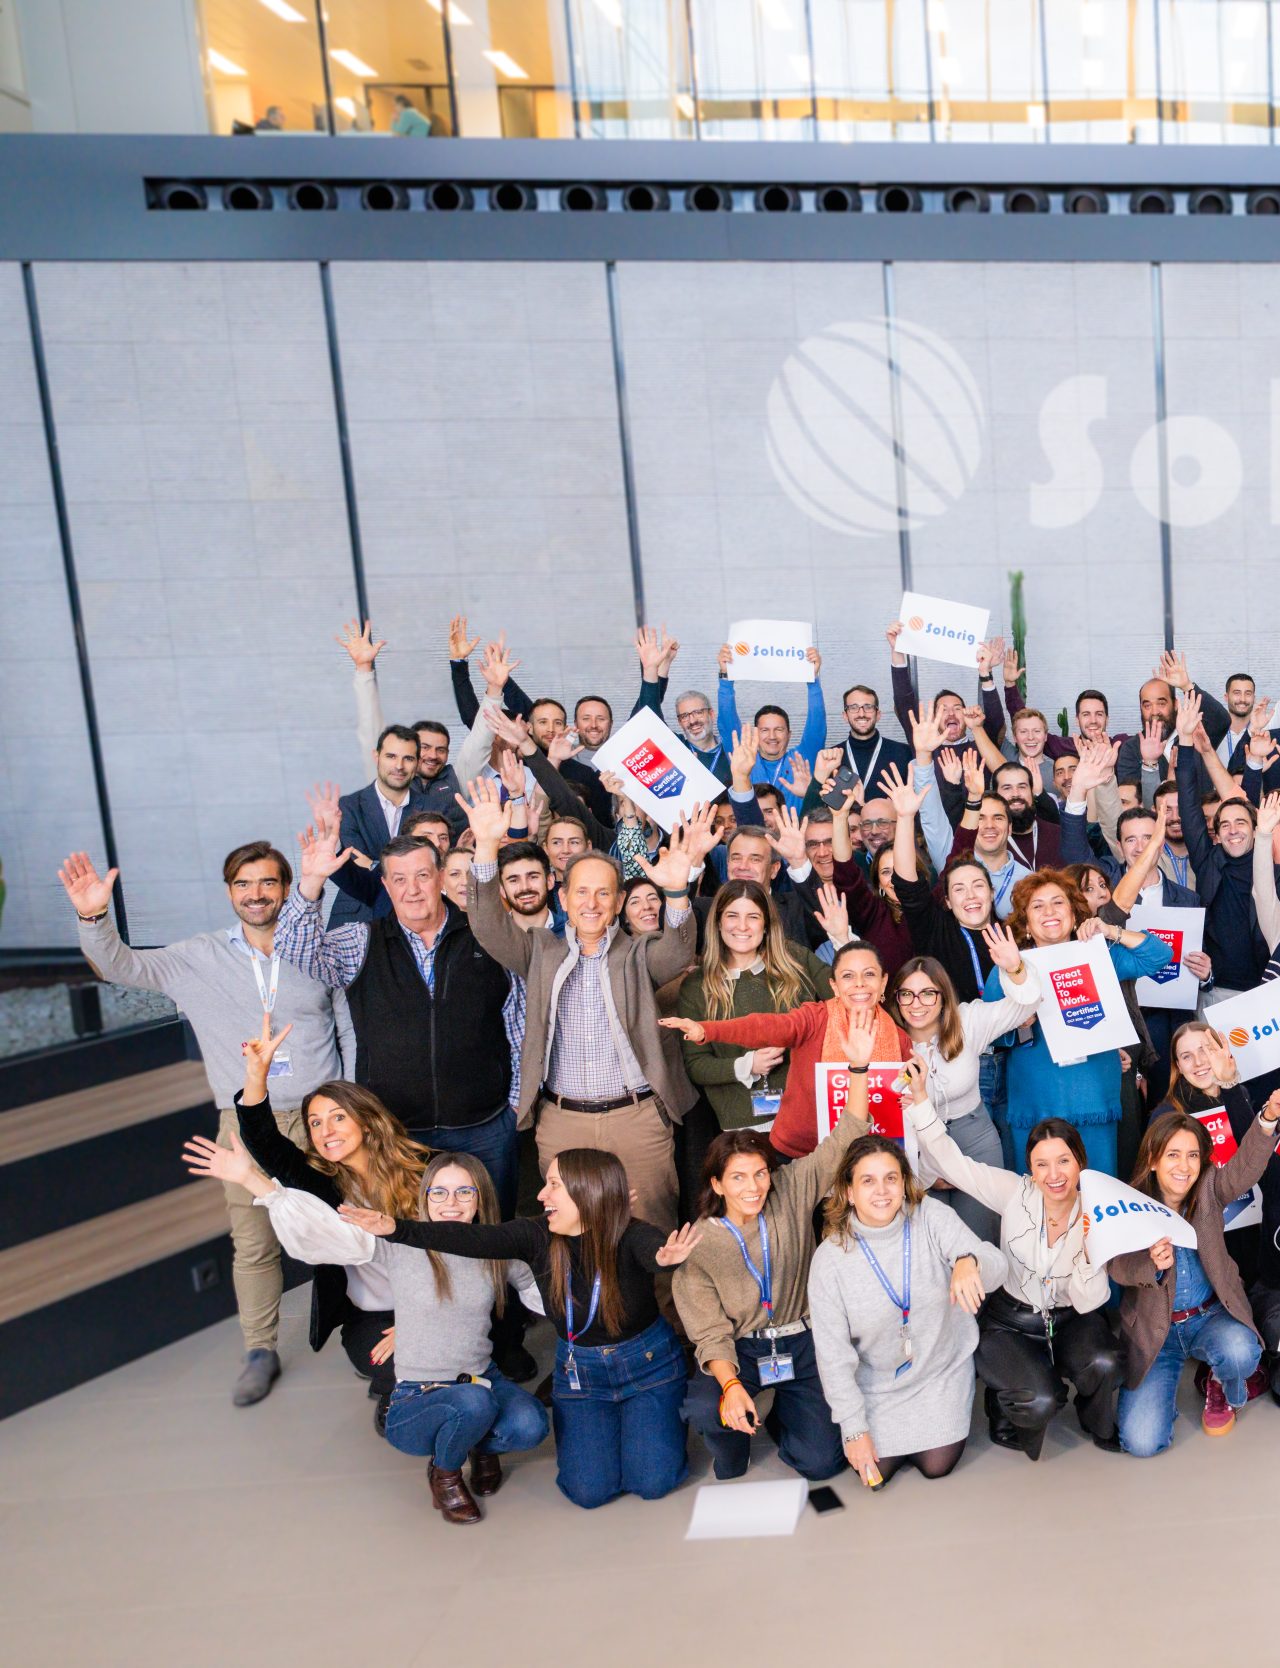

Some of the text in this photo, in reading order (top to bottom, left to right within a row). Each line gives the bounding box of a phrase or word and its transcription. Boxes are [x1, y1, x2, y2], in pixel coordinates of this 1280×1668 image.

[925, 623, 976, 645] Solarig
[753, 645, 805, 660] Solarig
[626, 747, 649, 766] Great
[632, 754, 654, 773] Place
[636, 770, 647, 779] To
[653, 770, 678, 792] Certified
[1053, 969, 1082, 981] Great
[1056, 978, 1083, 989] Place
[1066, 1005, 1100, 1017] Certified
[1094, 1199, 1172, 1223] Solarig
